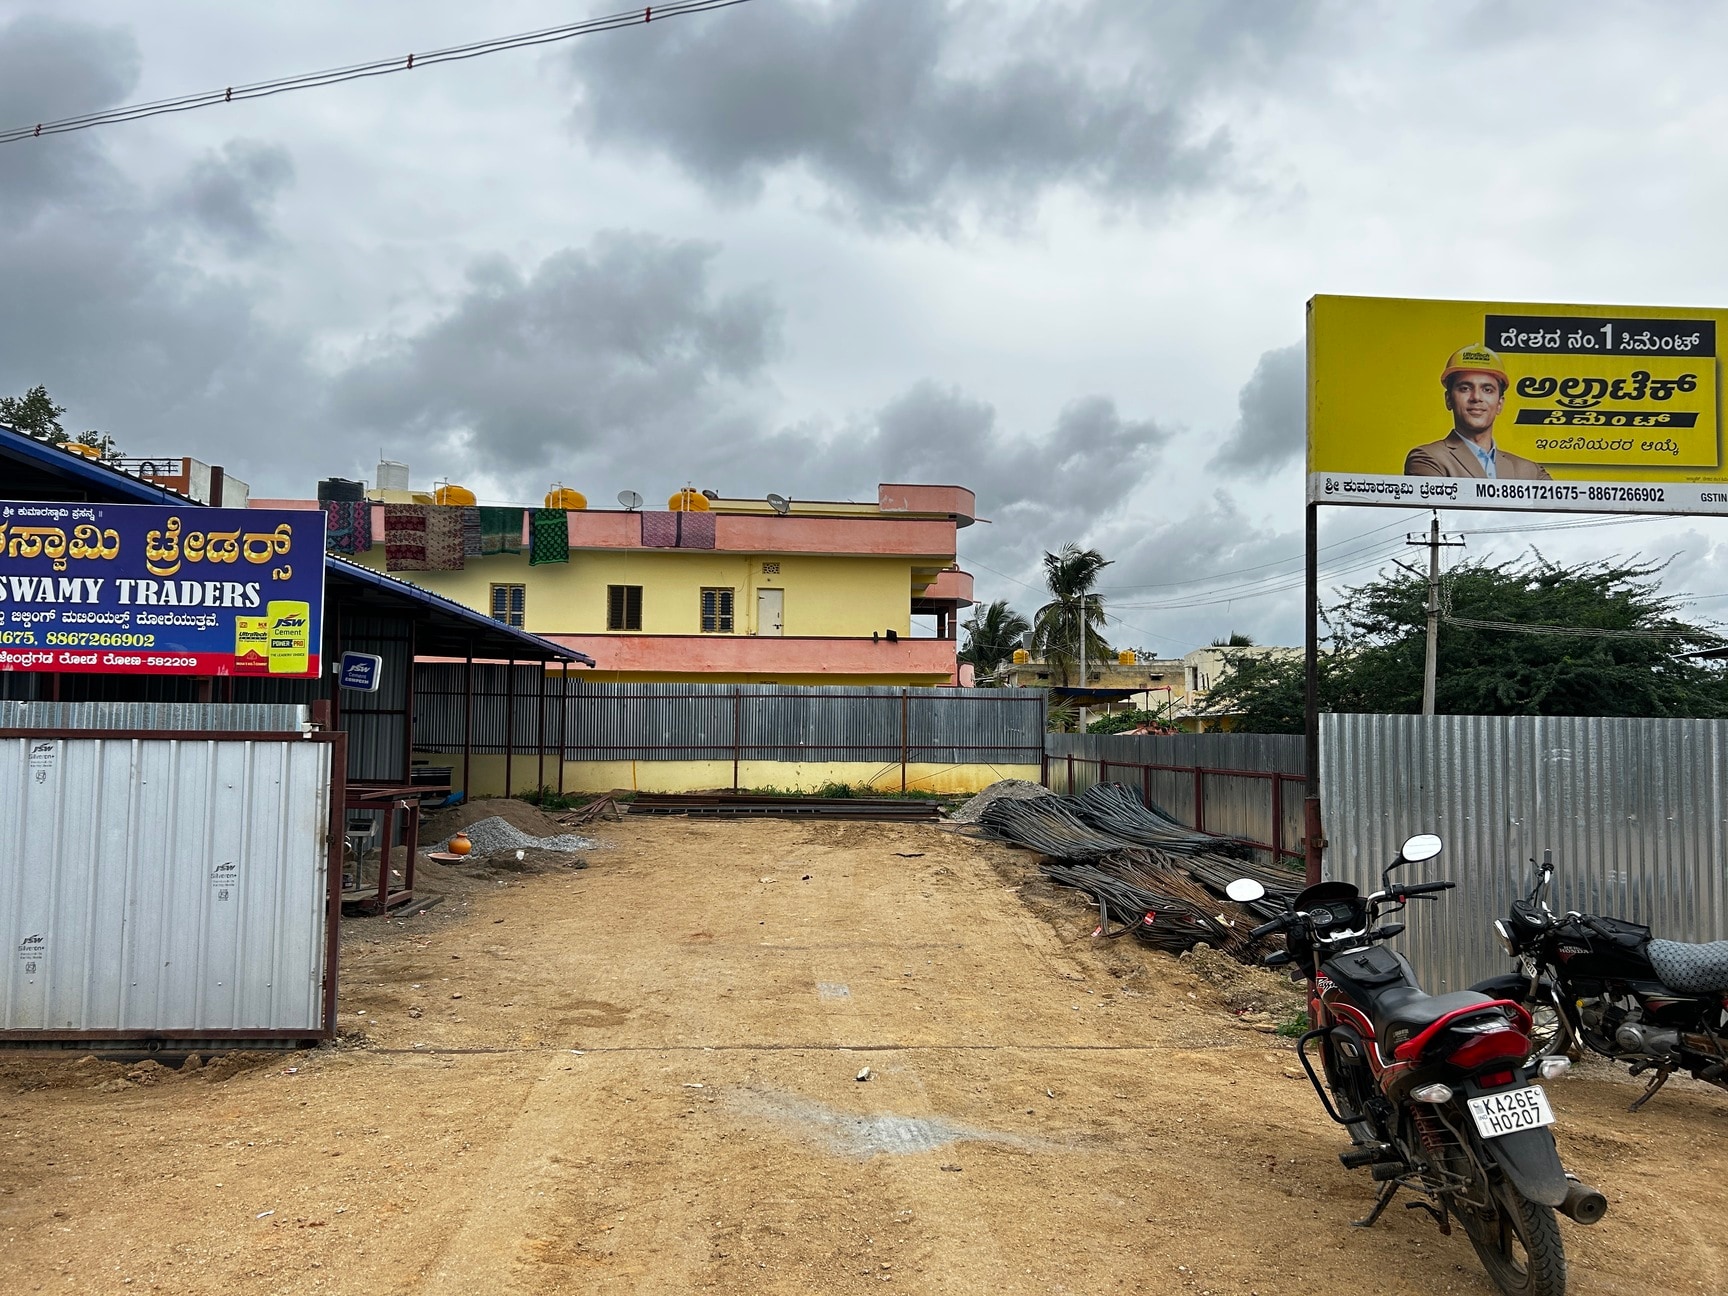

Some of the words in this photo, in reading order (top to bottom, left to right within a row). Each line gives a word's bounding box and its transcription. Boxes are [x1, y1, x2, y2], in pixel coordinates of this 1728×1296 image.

[1500, 328, 1561, 348] ದೇಶದ
[1620, 332, 1700, 351] ಸಿಮೆಂಟ್
[1543, 410, 1671, 427] ಸಿಮೆಂಟ್
[1325, 477, 1340, 494] ಶ್ರೀ
[1343, 479, 1414, 500] ಕುಮಾರಸ್ವಾಮಿ
[1700, 492, 1728, 503] GSTIN
[2, 506, 14, 518] ಶ್ರೀ
[146, 516, 292, 581] ಟ್ರೇಡರ್ಸ್
[115, 578, 260, 608] TRADERS
[272, 616, 306, 629] JSW
[46, 631, 155, 647] 8867266902
[1482, 1090, 1538, 1116] KA26E
[1489, 1106, 1541, 1133] H0207
